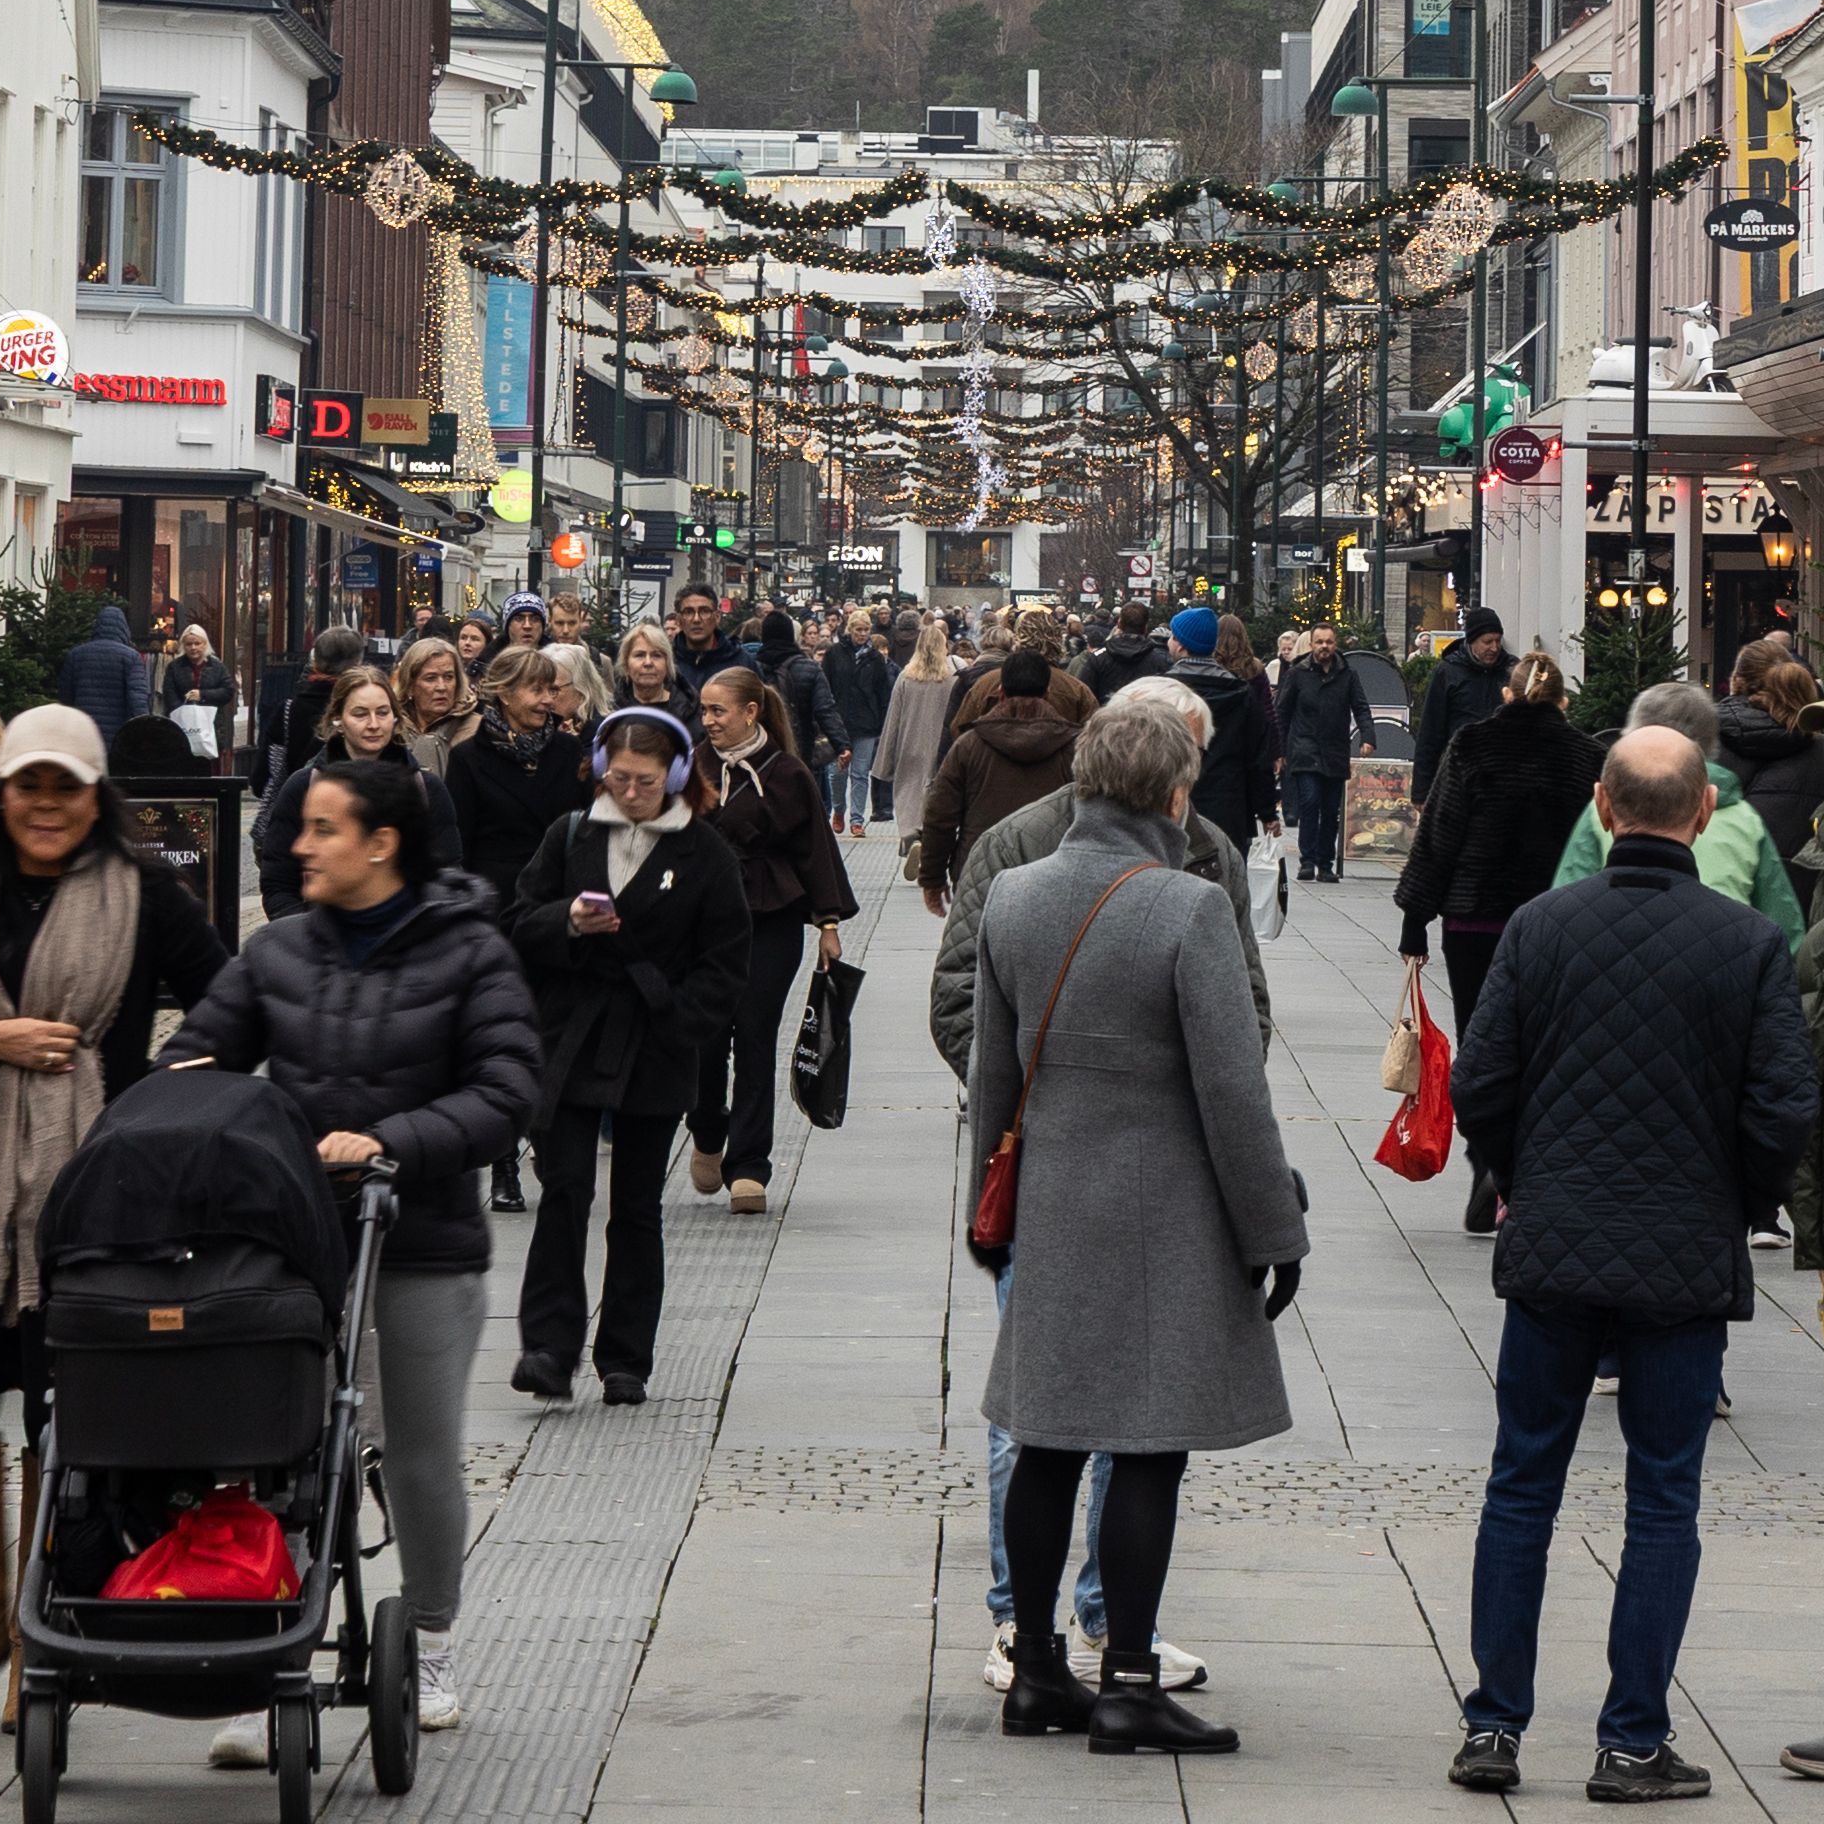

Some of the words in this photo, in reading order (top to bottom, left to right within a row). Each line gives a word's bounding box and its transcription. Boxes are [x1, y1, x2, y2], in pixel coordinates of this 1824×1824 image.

[1421, 3, 1442, 12] LEIE
[1710, 221, 1728, 236] PÅ
[1731, 223, 1795, 236] MARKENS
[73, 372, 227, 406] essmann
[1499, 447, 1541, 458] COSTA
[409, 461, 451, 473] Kitch'n
[1657, 494, 1771, 524] PSTA
[1294, 549, 1314, 558] nor
